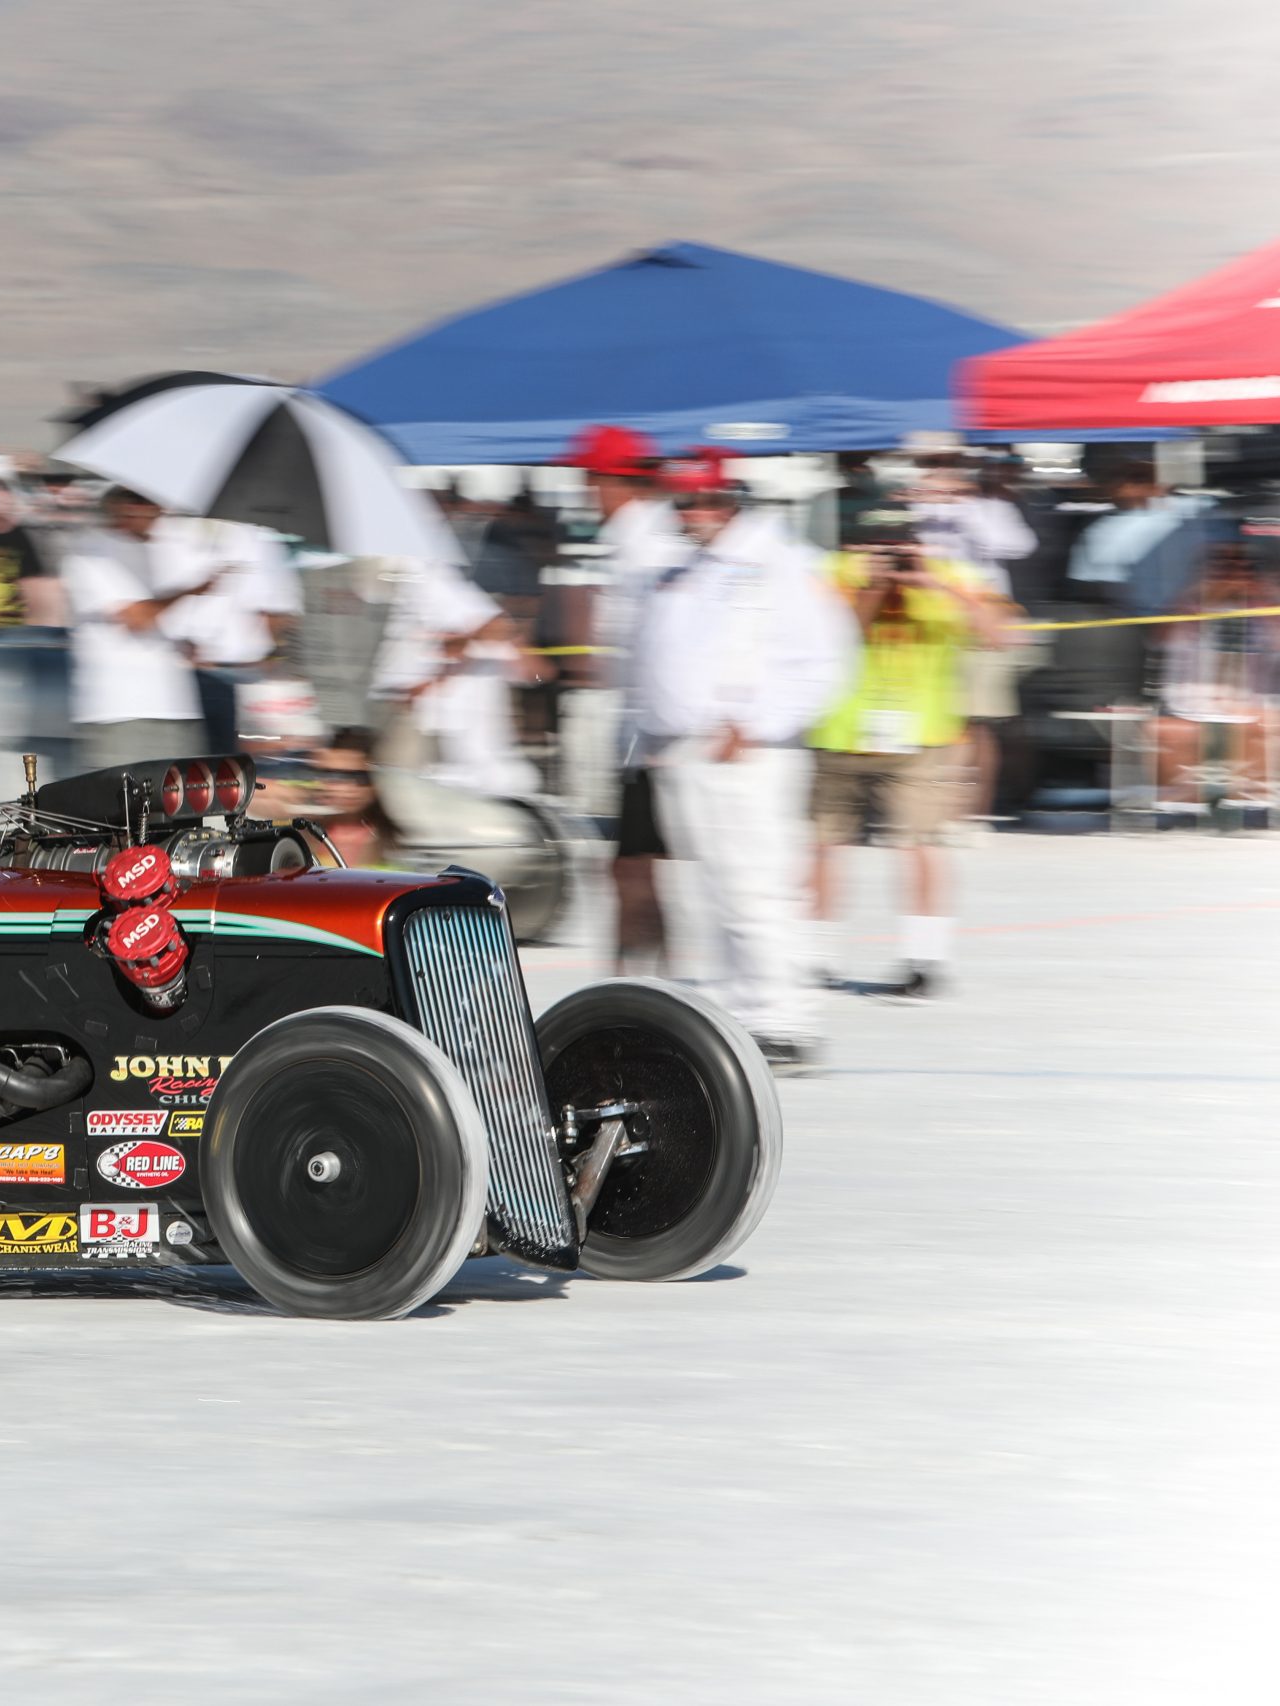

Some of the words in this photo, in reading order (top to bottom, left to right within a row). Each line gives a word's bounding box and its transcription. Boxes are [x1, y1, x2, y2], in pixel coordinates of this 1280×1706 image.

[117, 854, 156, 888] MSD
[122, 913, 160, 949] MSD
[110, 1055, 211, 1081] JOHN
[88, 1113, 165, 1126] ODYSSEY
[126, 1156, 150, 1171] RED
[41, 1241, 78, 1253] WEAR
